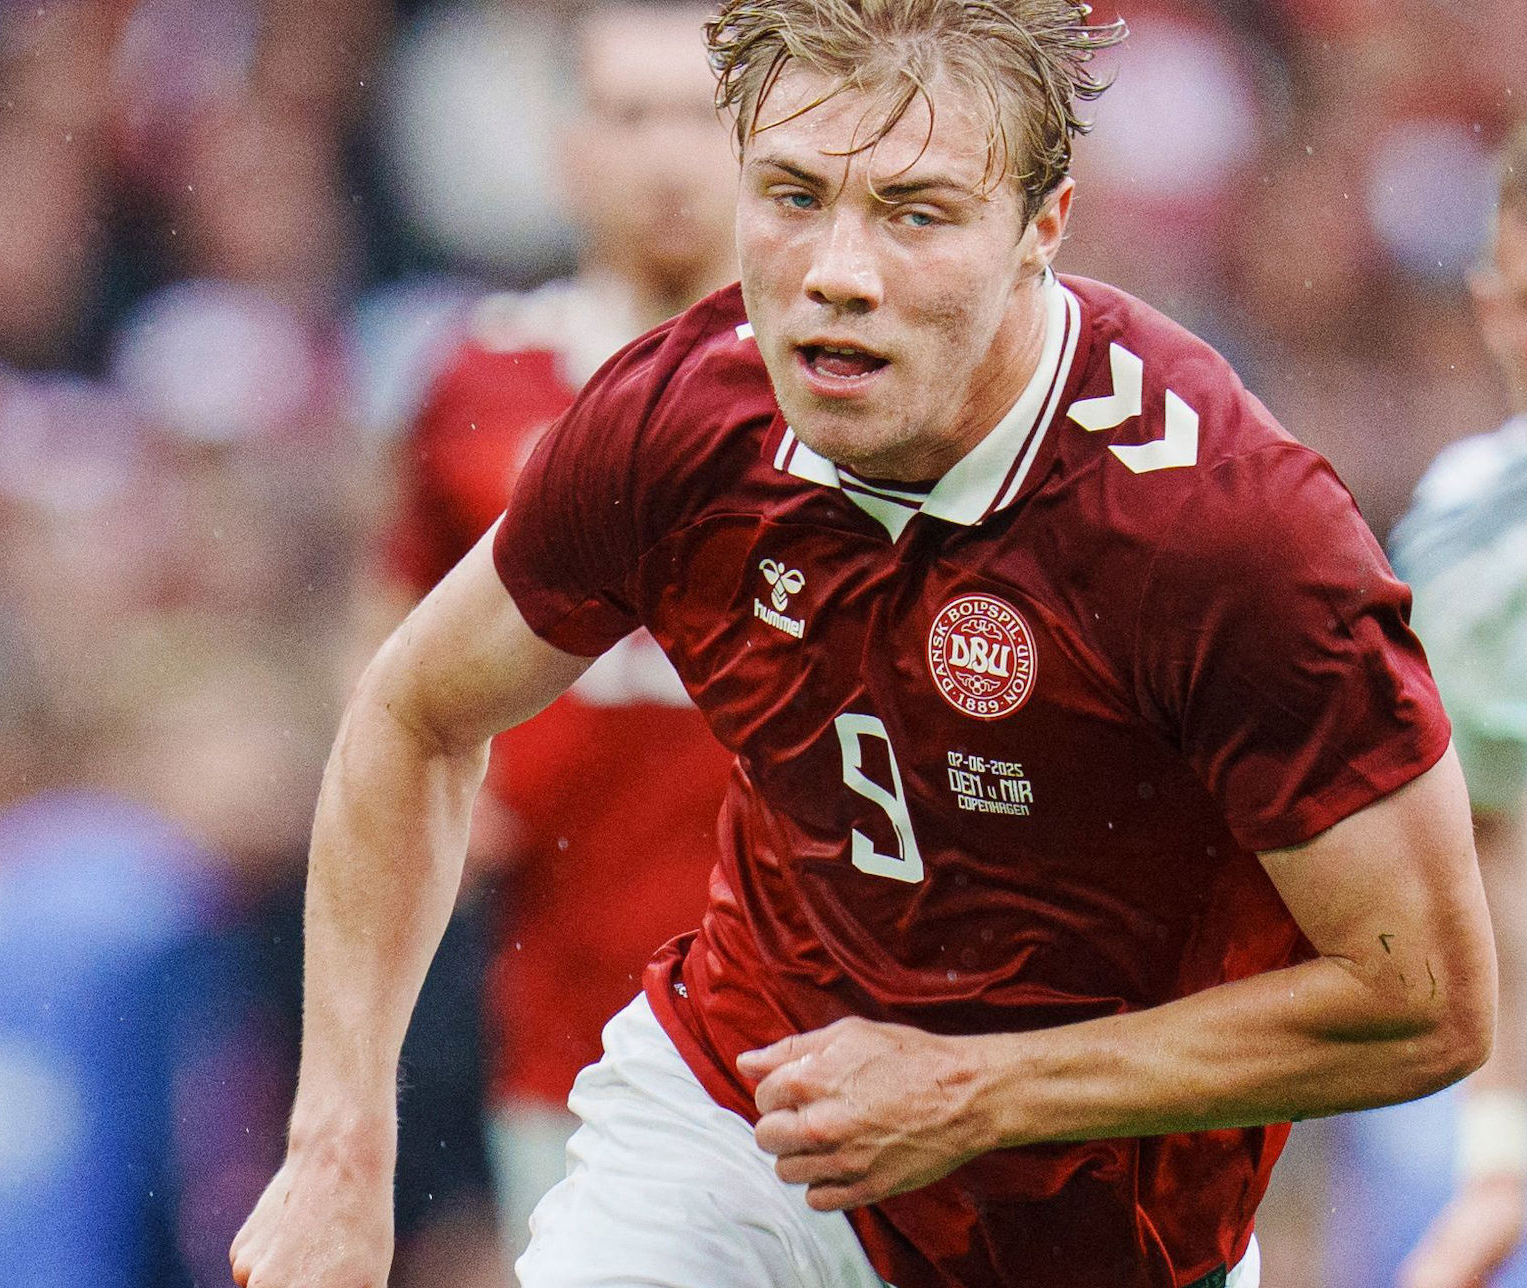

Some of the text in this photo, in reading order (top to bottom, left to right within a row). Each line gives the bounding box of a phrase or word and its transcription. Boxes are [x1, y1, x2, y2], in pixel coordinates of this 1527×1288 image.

[753, 597, 806, 639] hummel
[932, 622, 954, 693] DANSK
[949, 634, 1012, 677] DBU
[956, 692, 1000, 714] 1889
[947, 751, 1025, 777] 07-06-2025
[834, 712, 924, 883] 9
[947, 767, 984, 798] DEN
[999, 778, 1034, 803] NIR
[957, 794, 1030, 816] COPENHAGEN
